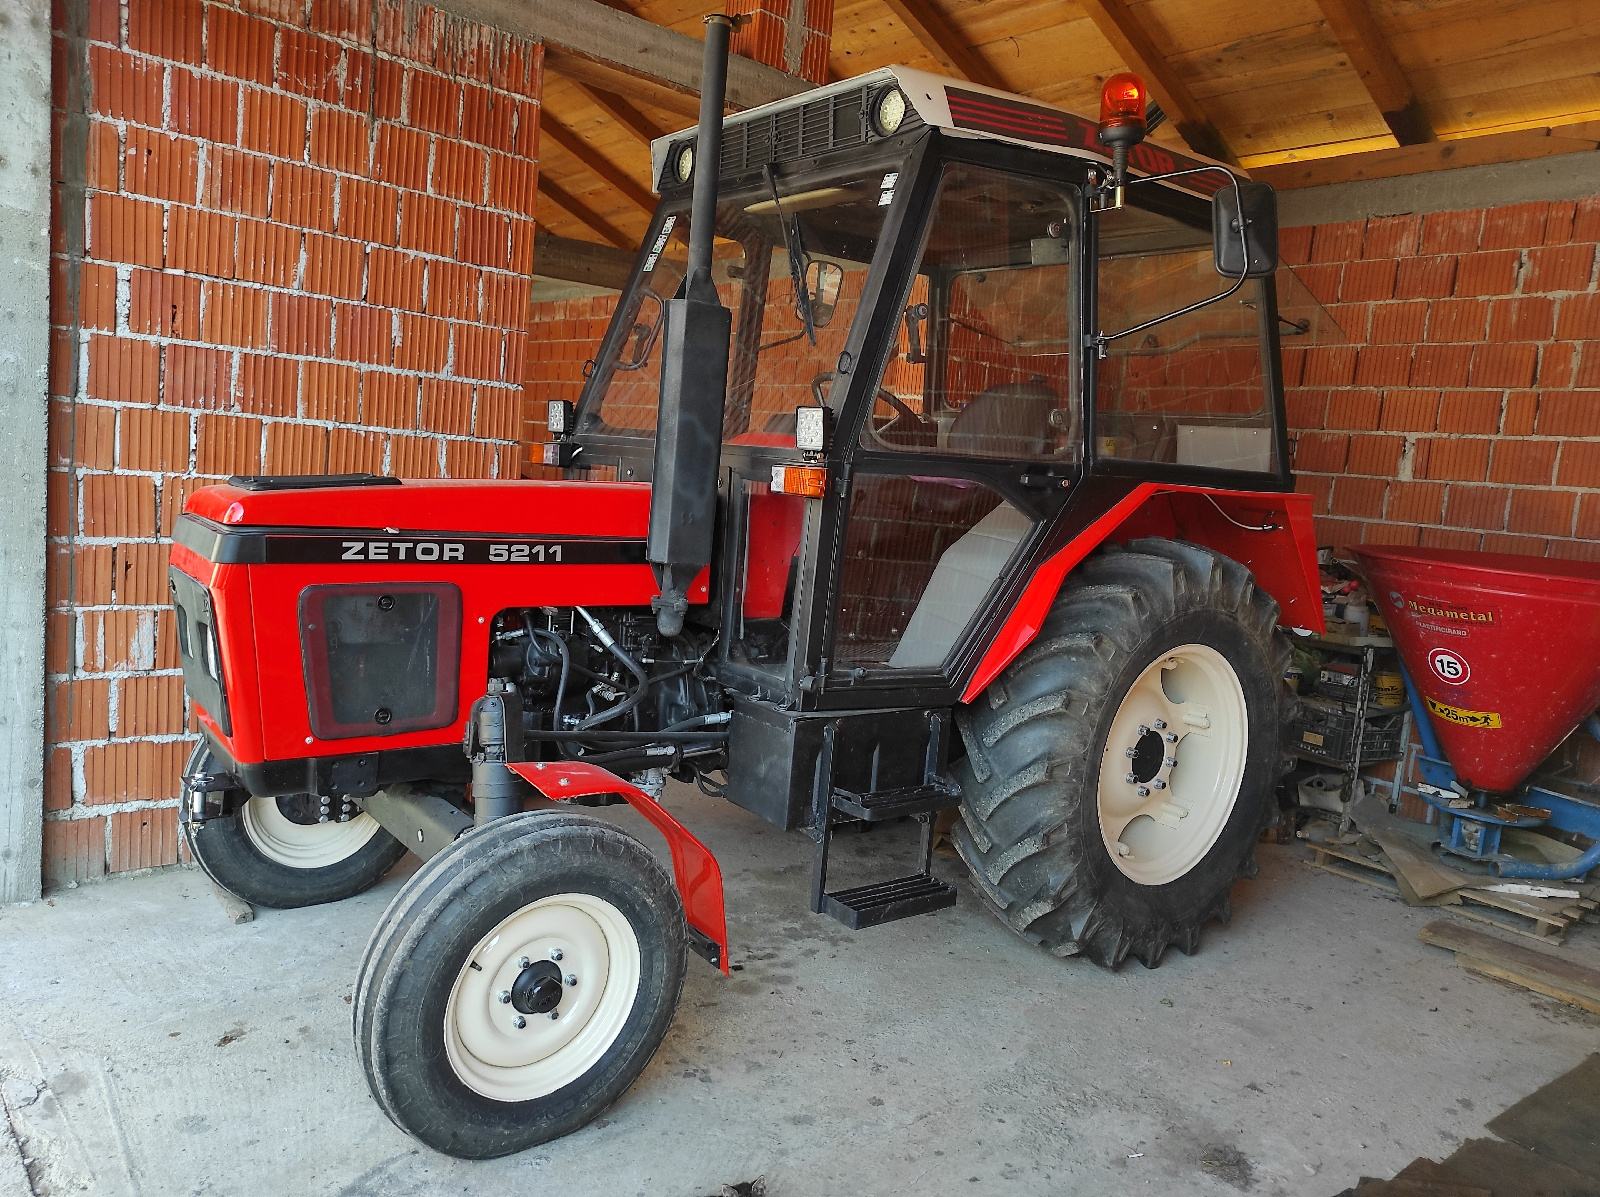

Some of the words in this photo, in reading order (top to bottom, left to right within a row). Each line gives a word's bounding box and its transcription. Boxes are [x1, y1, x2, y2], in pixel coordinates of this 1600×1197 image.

[1077, 120, 1175, 173] ZOR
[341, 541, 465, 561] ZETOR
[488, 544, 562, 562] 5211
[1408, 600, 1494, 622] Megametal
[1436, 658, 1460, 676] 15
